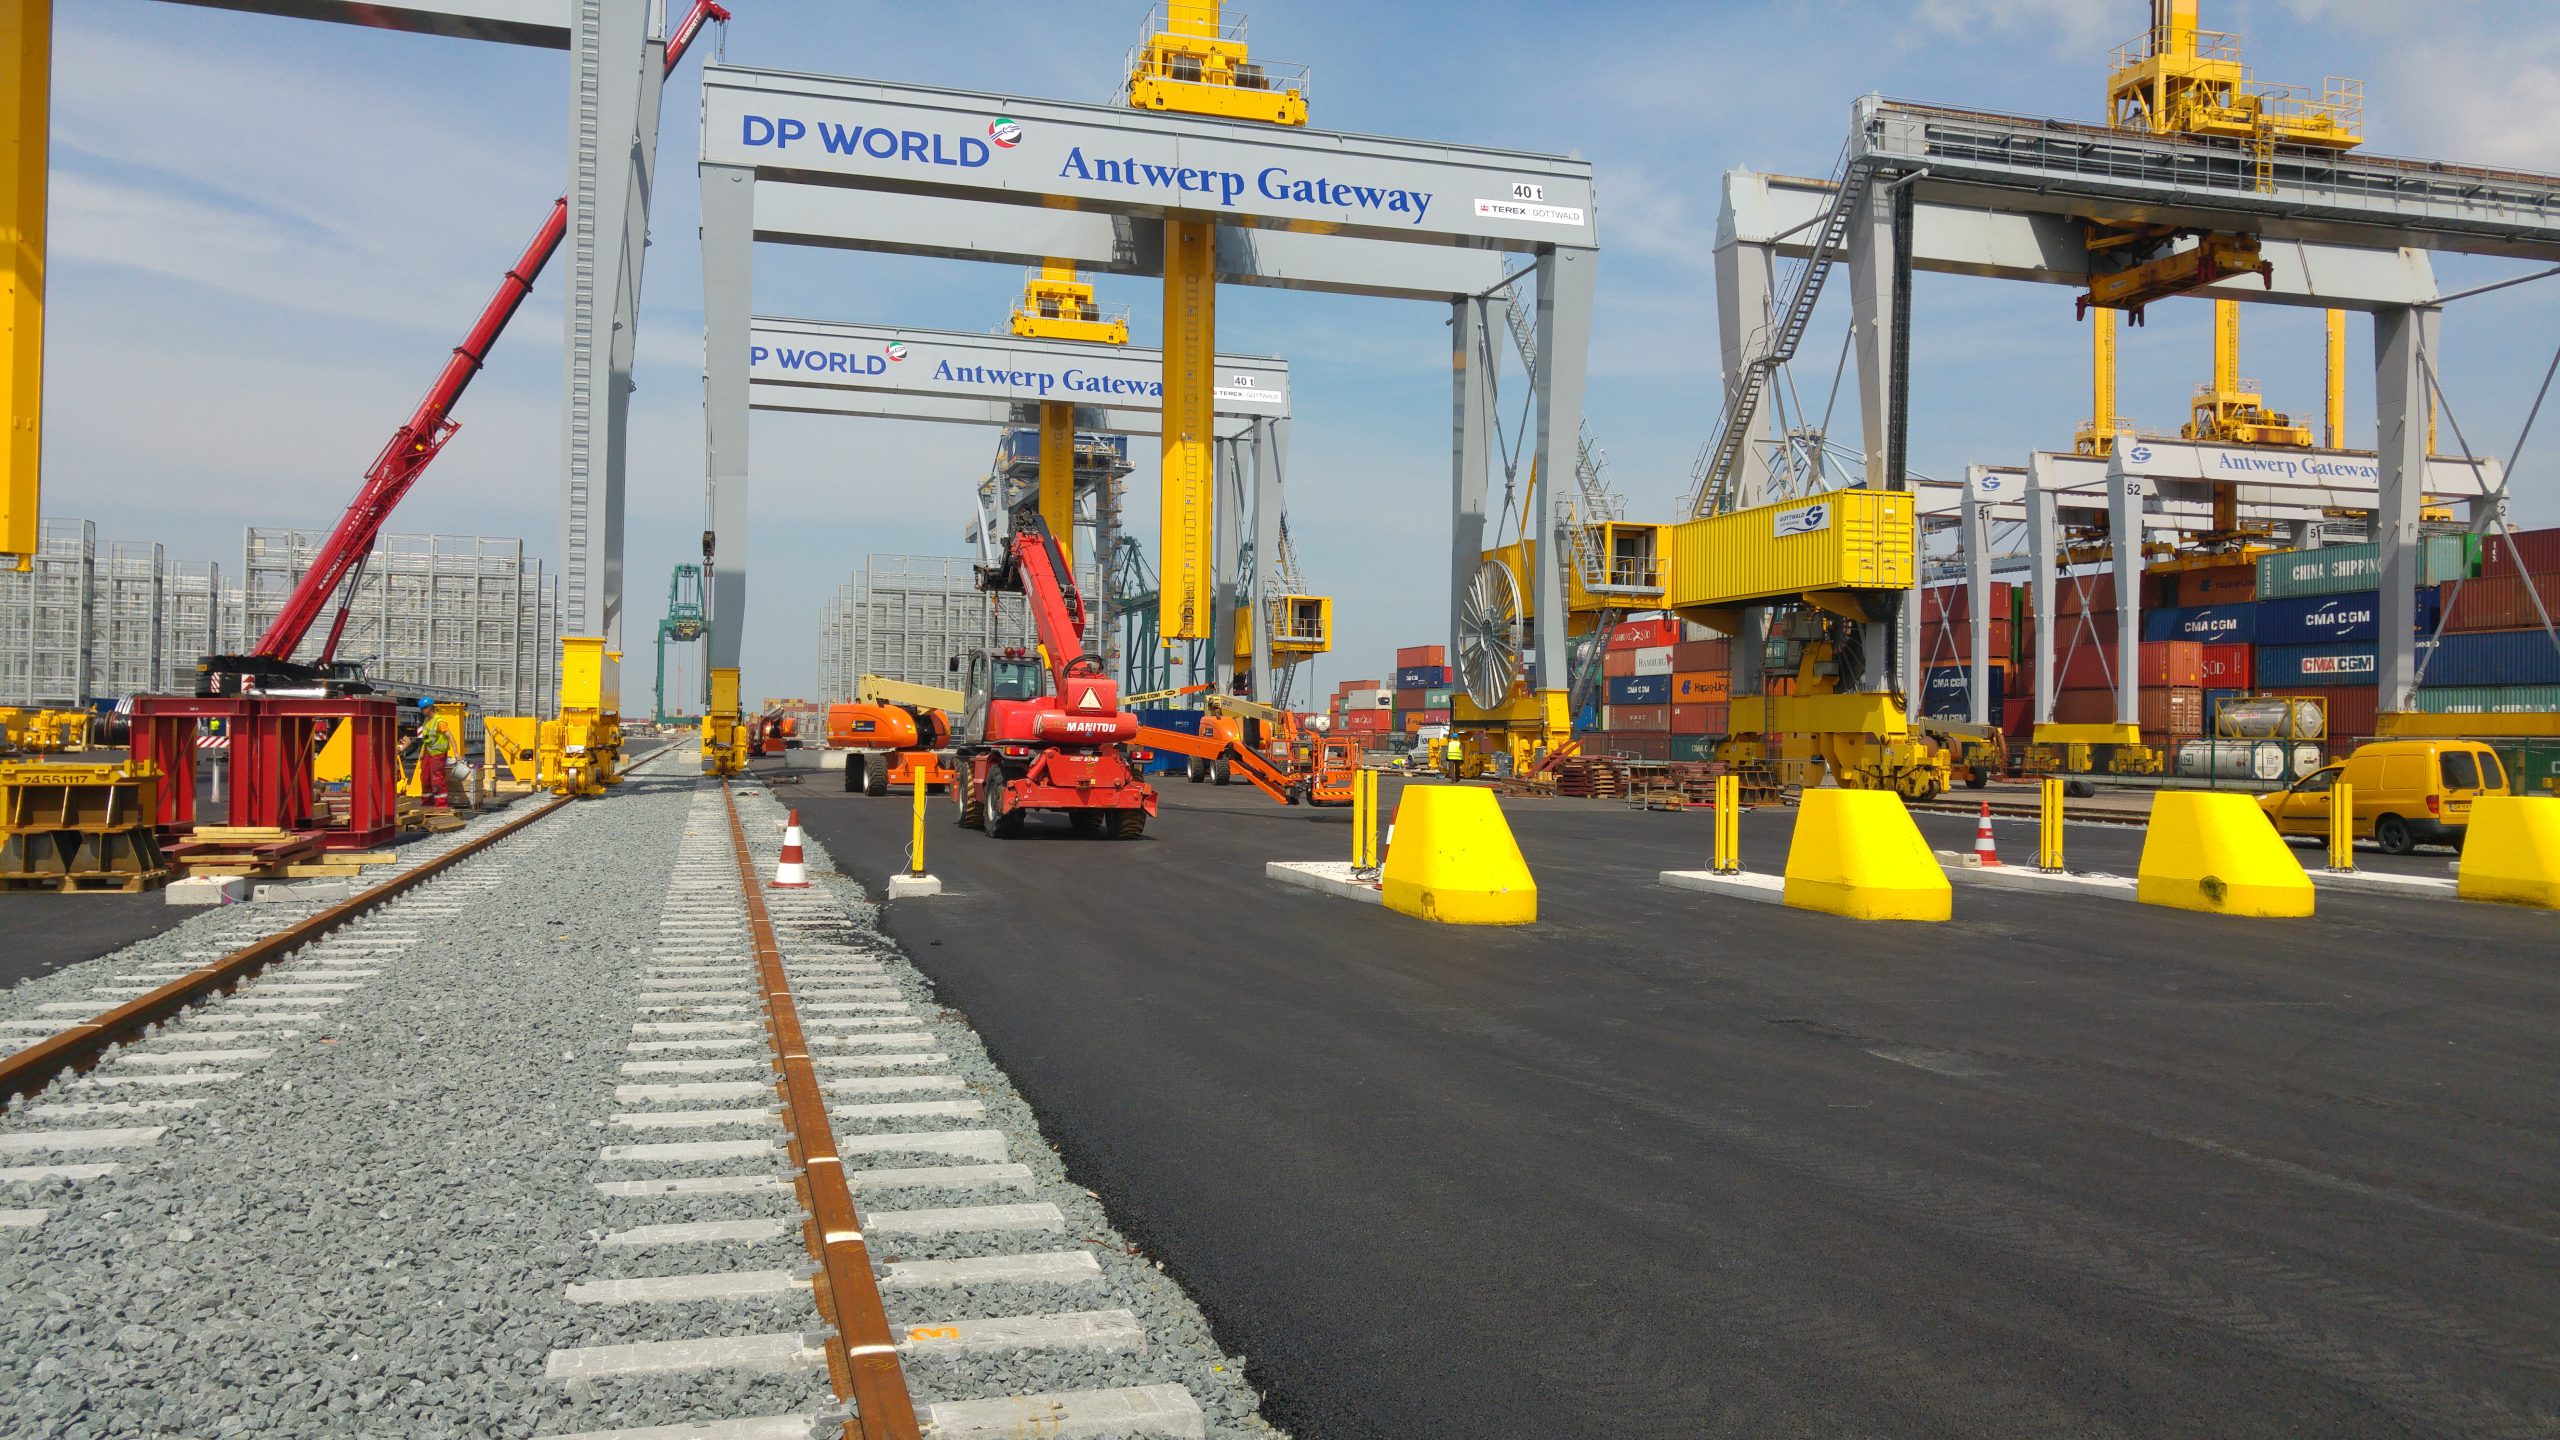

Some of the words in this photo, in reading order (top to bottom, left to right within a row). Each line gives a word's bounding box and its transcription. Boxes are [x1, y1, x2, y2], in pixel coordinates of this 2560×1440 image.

[743, 115, 806, 149] DP
[817, 122, 990, 168] WORLD
[1059, 147, 1245, 206] Antwerp
[1258, 167, 1433, 224] Gateway
[1513, 185, 1532, 199] 40
[1537, 187, 1543, 200] t
[1491, 205, 1526, 215] TEREX
[1532, 209, 1580, 221] GOTTWALD
[751, 346, 769, 367] P
[776, 348, 887, 376] WORLD
[932, 359, 1055, 395] Antwerp
[1063, 369, 1163, 397] Gatewa
[1234, 376, 1247, 386] 40
[1250, 378, 1254, 386] t
[2219, 452, 2297, 479] Antwerp
[2301, 457, 2379, 484] Gateway
[2126, 484, 2141, 496] 52
[1978, 510, 1990, 520] 51
[2292, 563, 2325, 581] CHINA
[2184, 620, 2208, 632] CMA
[2210, 618, 2237, 631] CGM
[2305, 613, 2335, 626] CMA
[2338, 610, 2371, 624] CGM
[2201, 660, 2226, 676] SÜD
[2303, 658, 2336, 673] CMA
[2337, 656, 2372, 671] CGM
[1932, 678, 1949, 688] CMA
[1066, 722, 1117, 733] MANITOU
